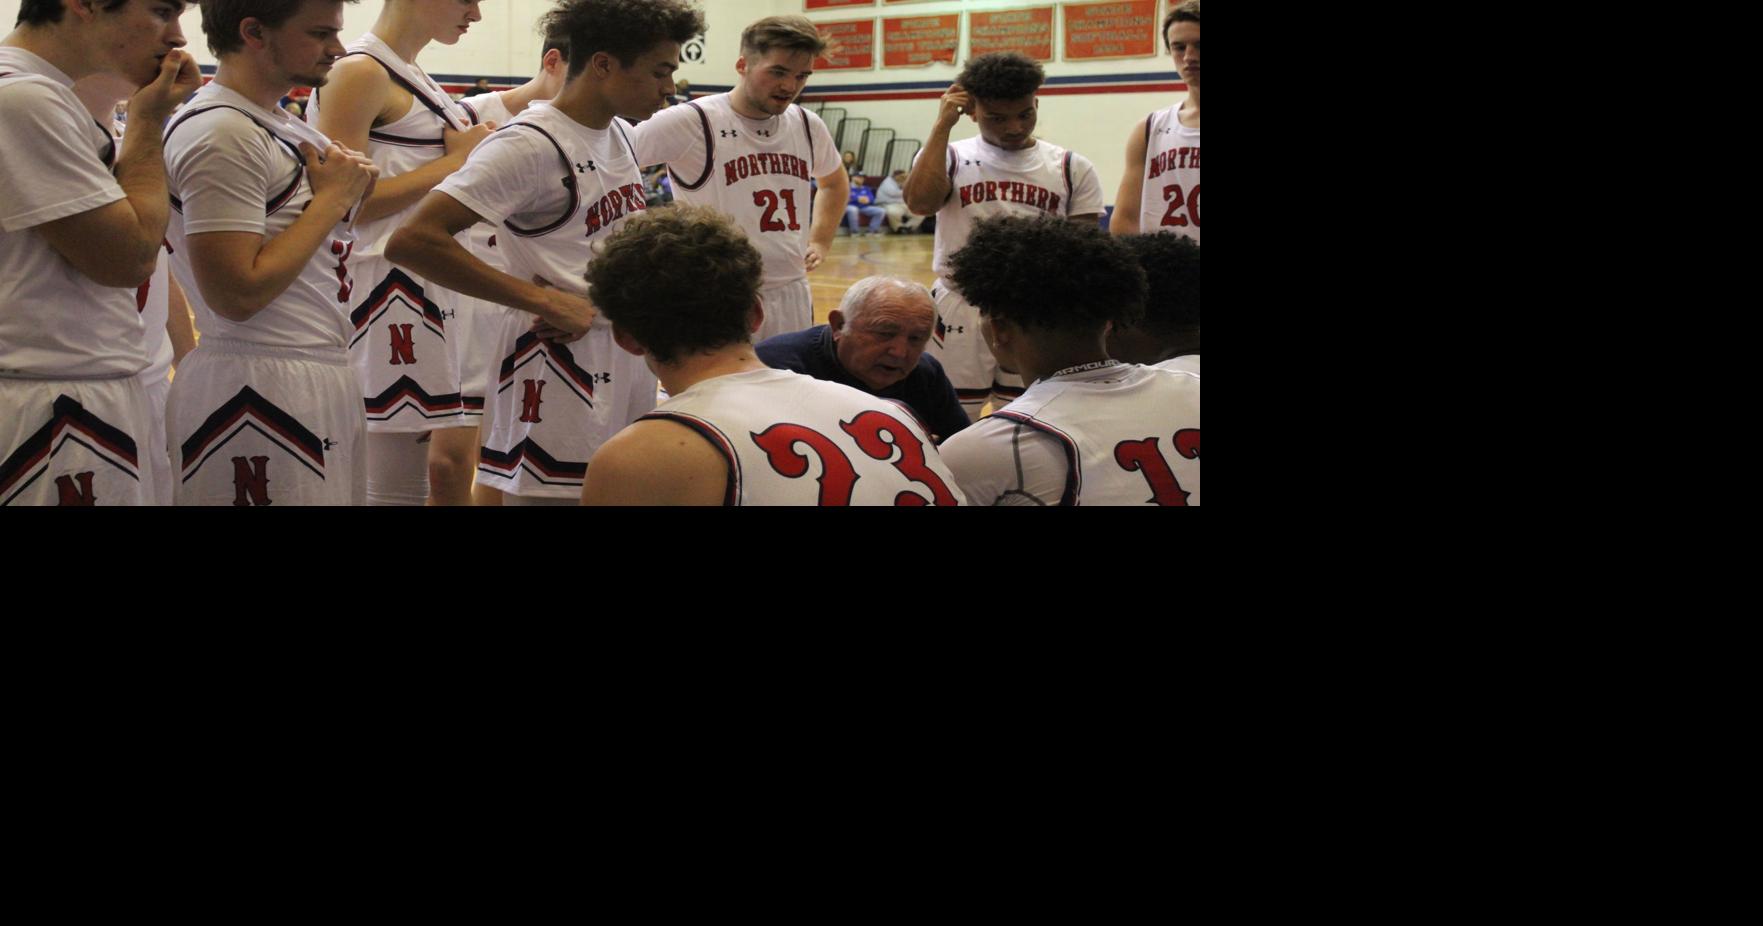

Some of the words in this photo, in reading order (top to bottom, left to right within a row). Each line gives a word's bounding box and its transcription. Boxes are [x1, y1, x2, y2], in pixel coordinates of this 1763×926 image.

[723, 153, 810, 187] NORTHERN
[752, 189, 801, 233] 21
[959, 181, 1061, 216] NORTHERN
[388, 322, 418, 366] N
[518, 378, 547, 424] N
[230, 455, 273, 506] N
